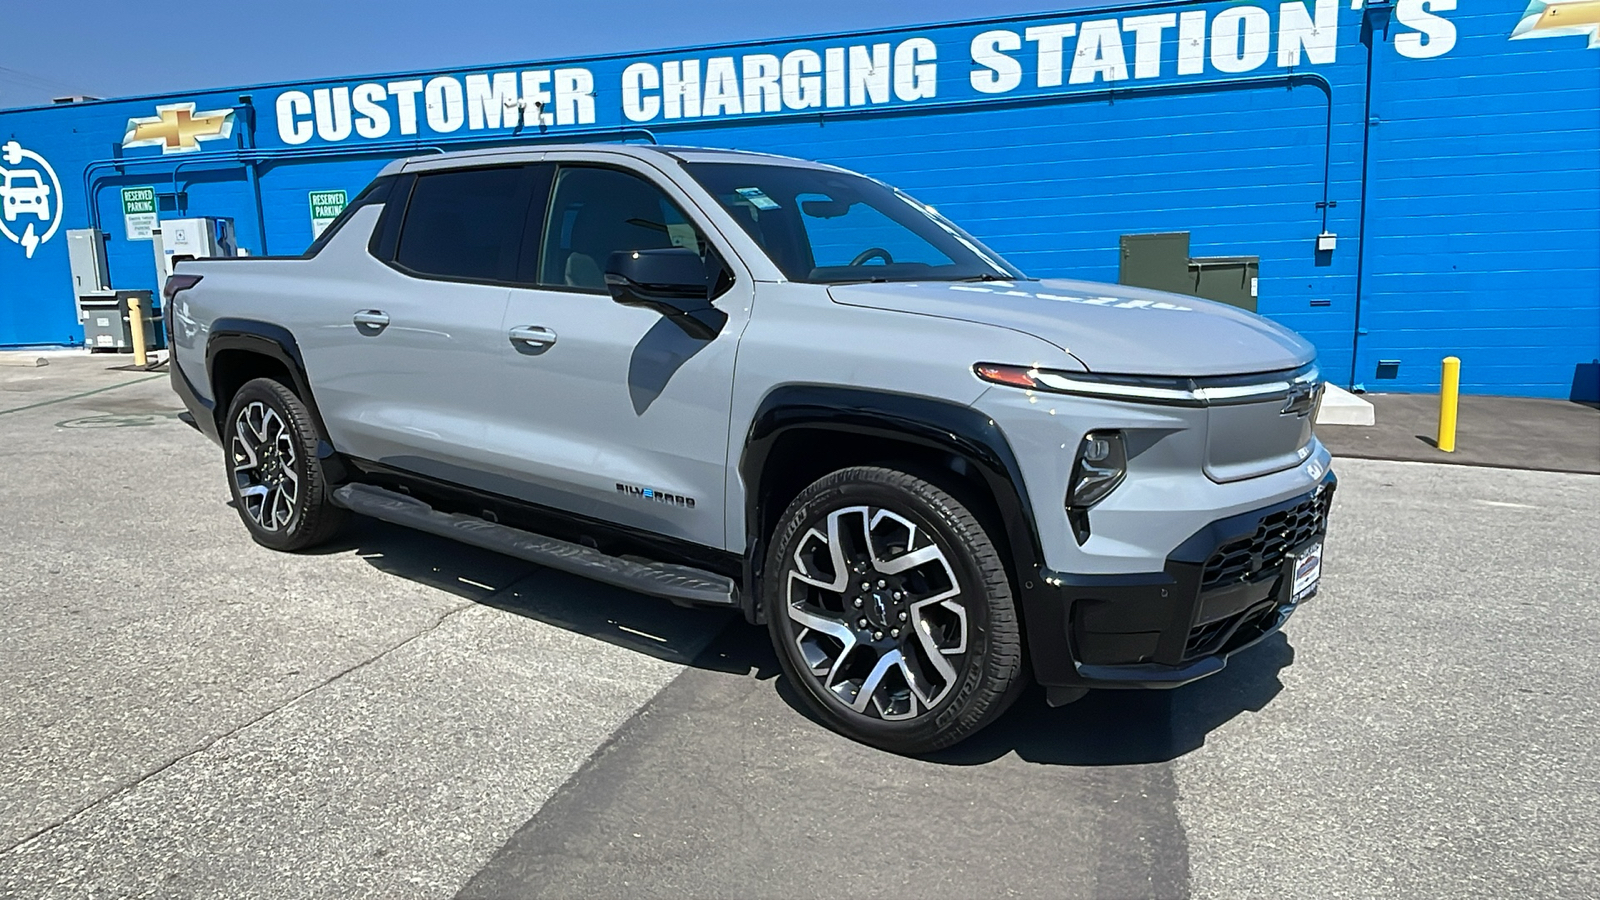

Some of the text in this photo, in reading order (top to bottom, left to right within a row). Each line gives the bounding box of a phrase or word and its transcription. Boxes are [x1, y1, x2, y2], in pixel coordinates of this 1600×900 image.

[276, 68, 596, 145] CUSTOMER
[622, 37, 937, 122] CHARGING
[124, 190, 153, 201] RESERVED
[312, 193, 344, 205] RESERVED
[127, 201, 153, 212] PARKING
